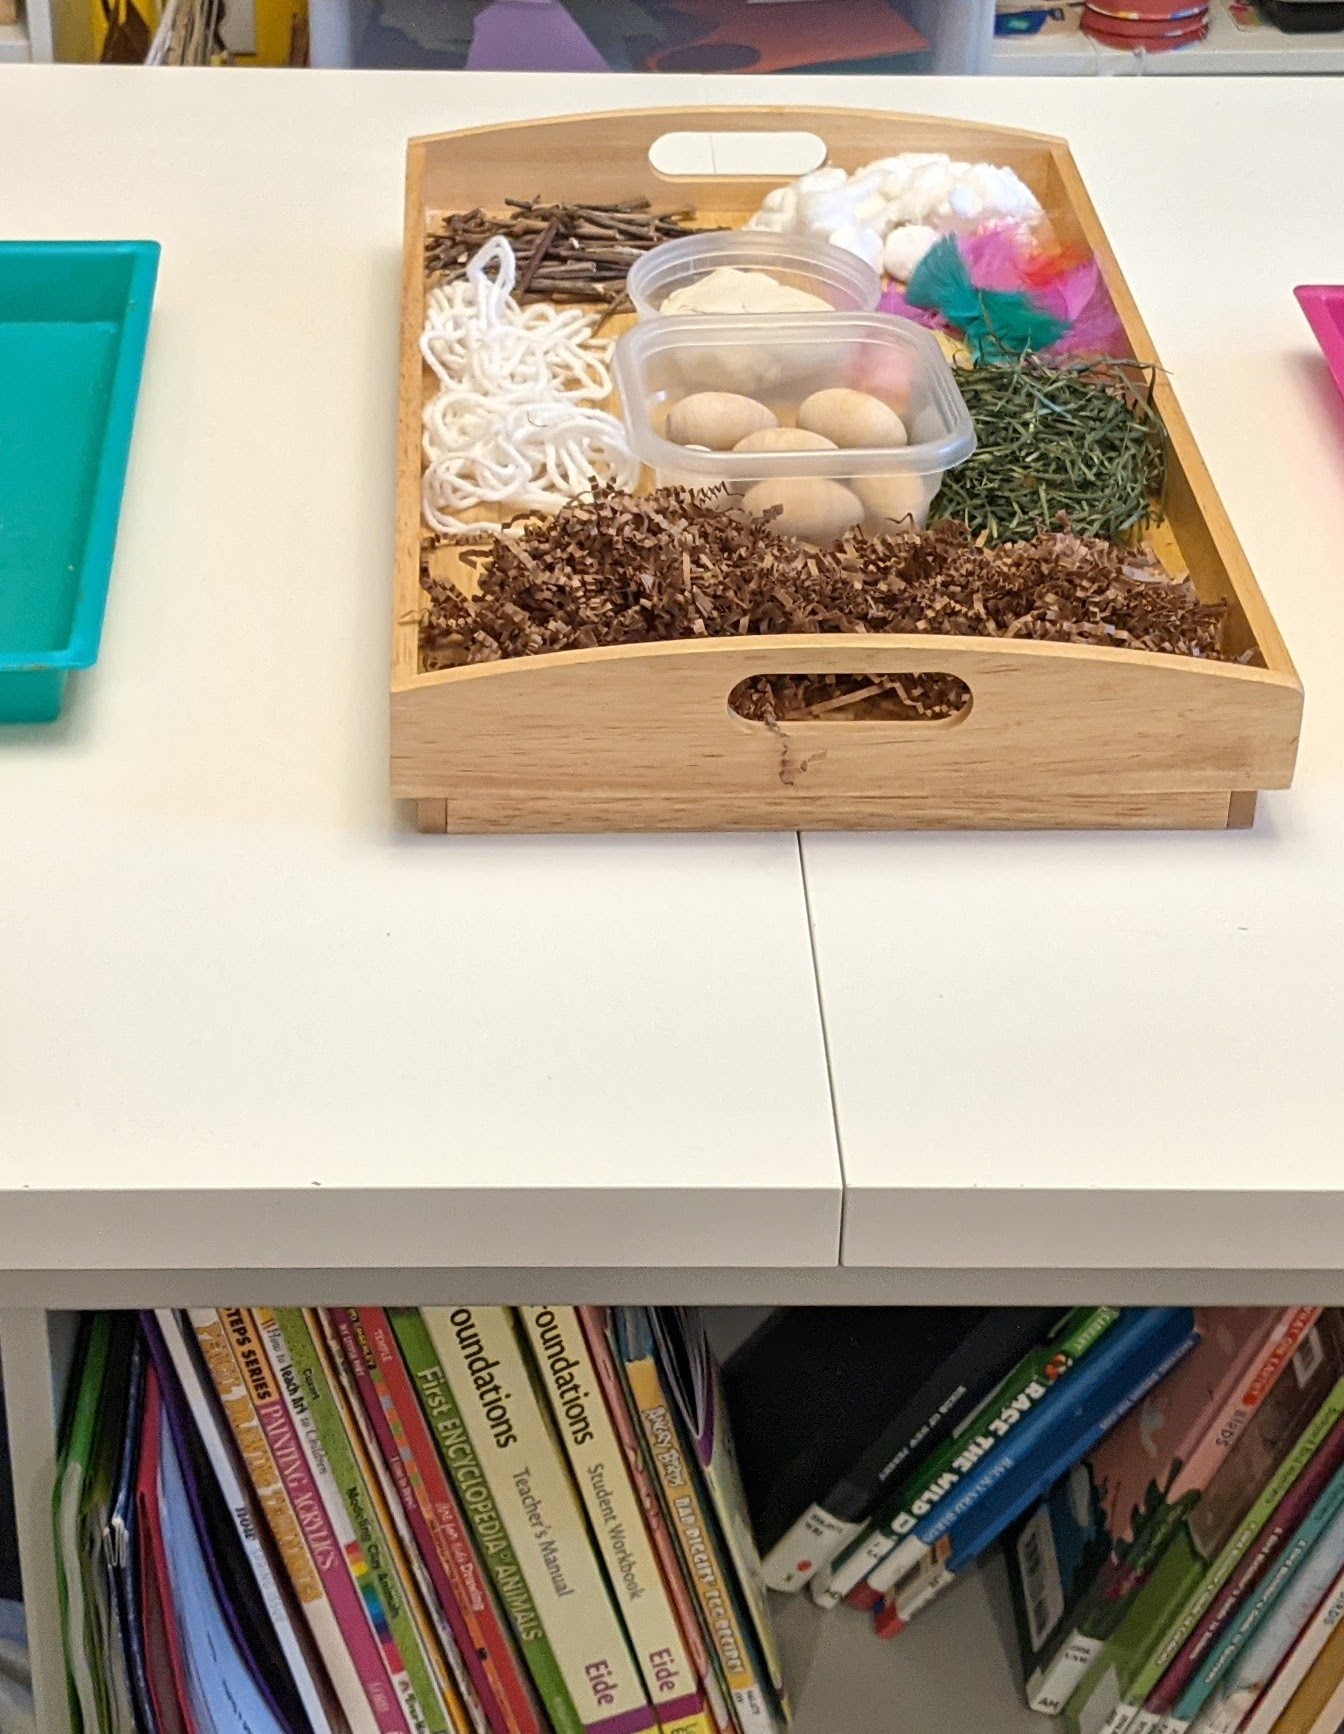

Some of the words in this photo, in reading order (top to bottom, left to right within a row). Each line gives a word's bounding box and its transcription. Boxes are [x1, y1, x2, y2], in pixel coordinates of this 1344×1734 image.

[240, 1347, 272, 1400] SERIES
[266, 1327, 284, 1352] How
[280, 1364, 301, 1395] Teach
[291, 1394, 307, 1415] Art
[450, 1306, 518, 1449] oundations
[532, 1306, 595, 1446] oundations
[642, 1404, 674, 1451] ANGRY
[990, 1379, 1045, 1437] RACE
[657, 1448, 687, 1489] BIRDS
[953, 1431, 995, 1474] THE
[259, 1404, 308, 1487] PAINTING
[294, 1490, 343, 1571] ACRYLICS
[418, 1365, 452, 1415] First
[437, 1418, 505, 1554] ENCYCLOPEDIA
[495, 1562, 540, 1641] ANIMALS
[910, 1468, 957, 1517] WILD
[512, 1468, 550, 1540] Teacher's
[538, 1539, 571, 1598] Manual
[586, 1462, 620, 1523] Student
[607, 1527, 643, 1600] Workbook
[585, 1659, 618, 1708] Eide
[648, 1647, 680, 1693] Eide
